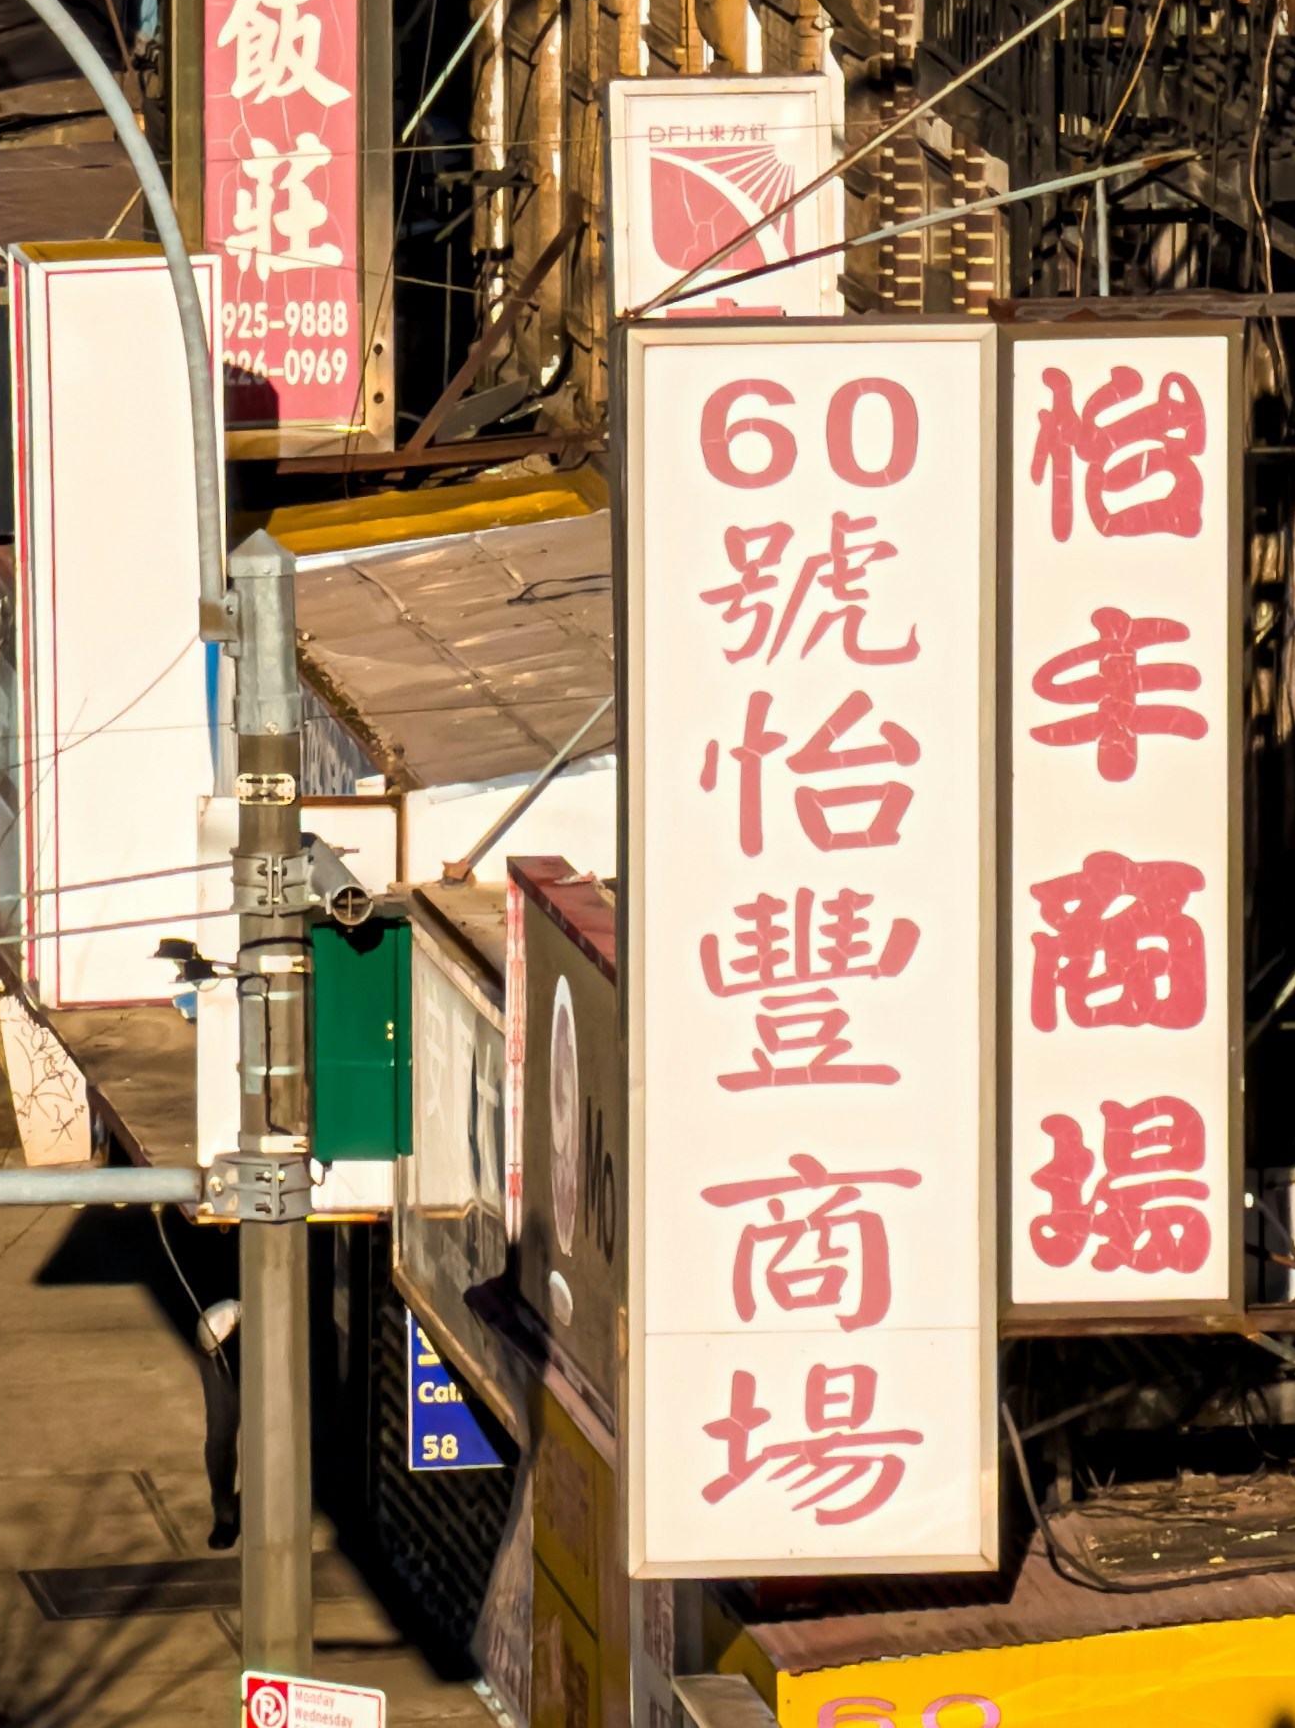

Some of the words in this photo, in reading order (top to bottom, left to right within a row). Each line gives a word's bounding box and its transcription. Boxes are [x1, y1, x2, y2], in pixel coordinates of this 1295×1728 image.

[649, 125, 703, 144] DFH
[221, 300, 349, 338] 925-9888
[422, 1433, 459, 1461] 58
